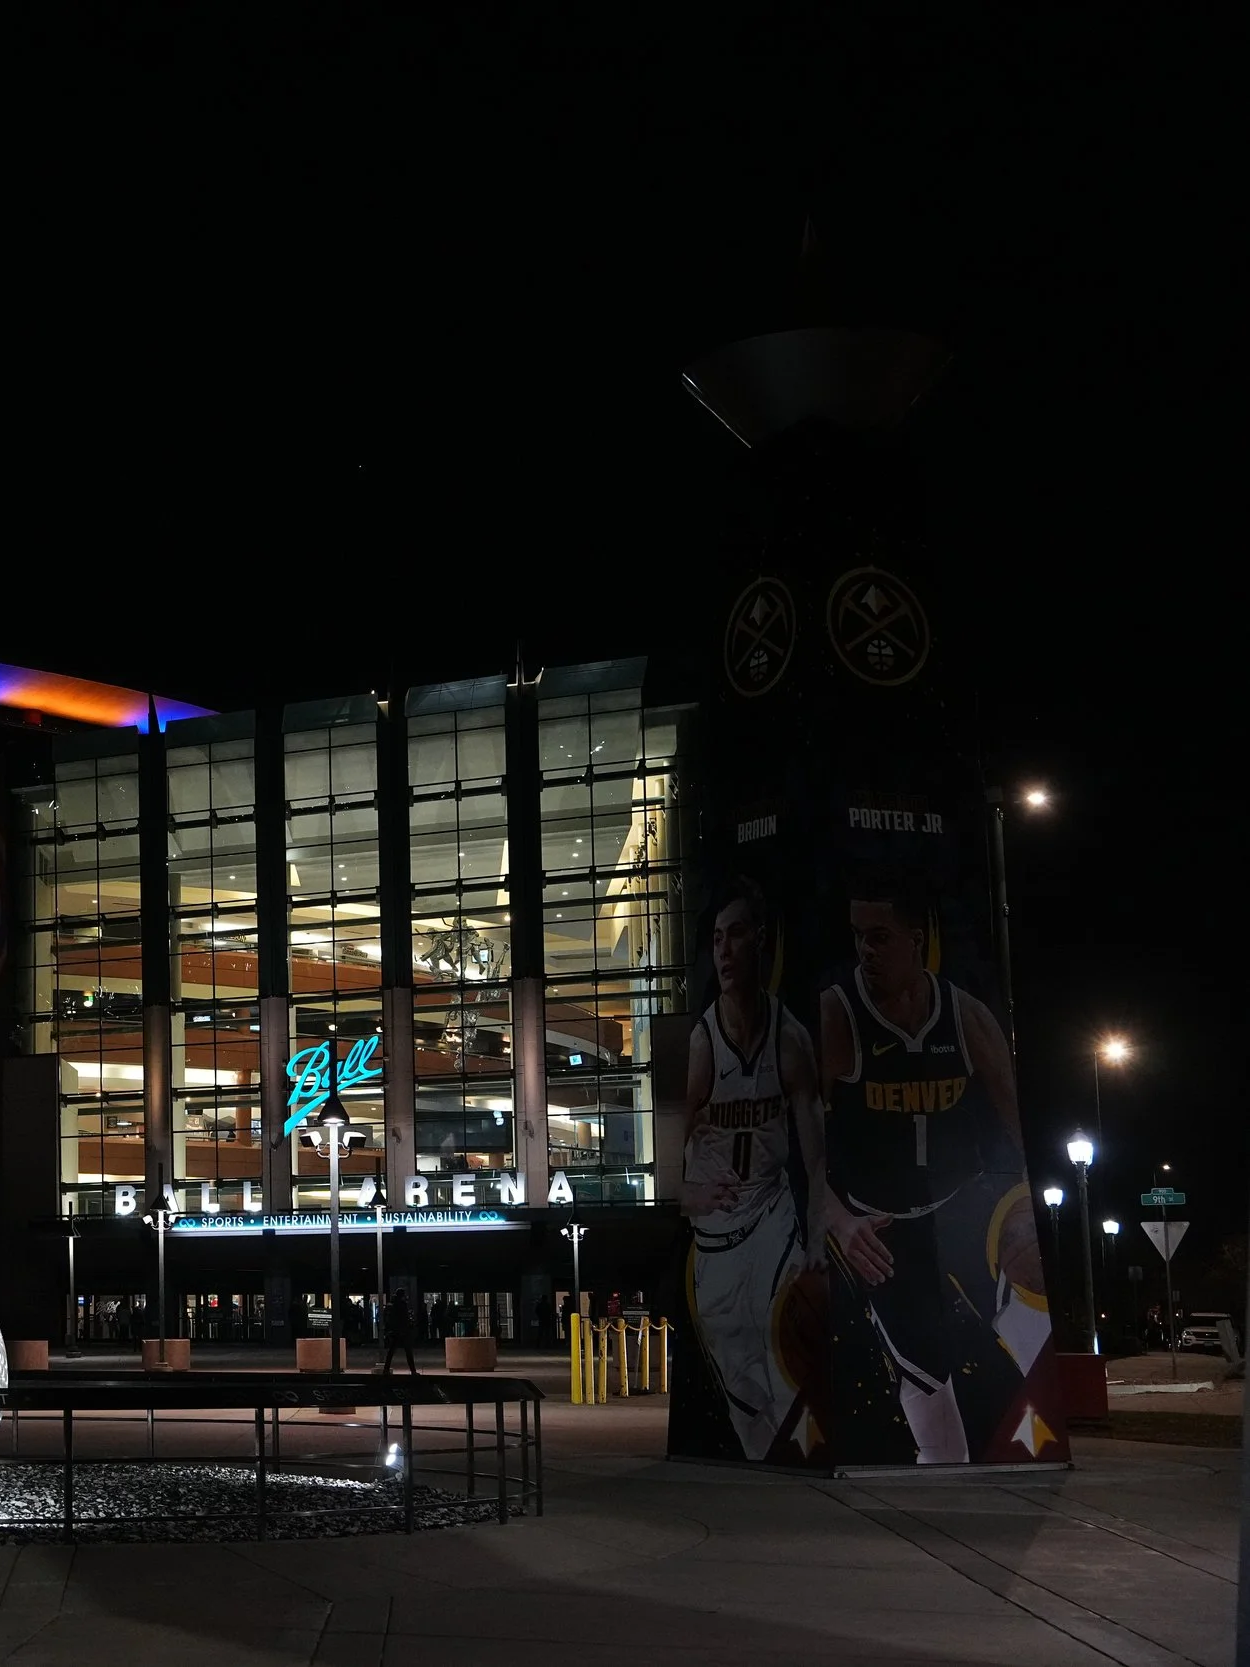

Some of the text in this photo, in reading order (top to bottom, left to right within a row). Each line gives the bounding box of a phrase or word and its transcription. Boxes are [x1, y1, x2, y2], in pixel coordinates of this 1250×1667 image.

[737, 814, 777, 844] BRAUN
[849, 807, 943, 834] PORTER JR
[865, 1077, 967, 1113] DENVER
[709, 1095, 782, 1129] NUGGETS
[912, 1114, 928, 1166] 1
[1152, 1195, 1166, 1204] 9th
[201, 1216, 244, 1227] SPORTS
